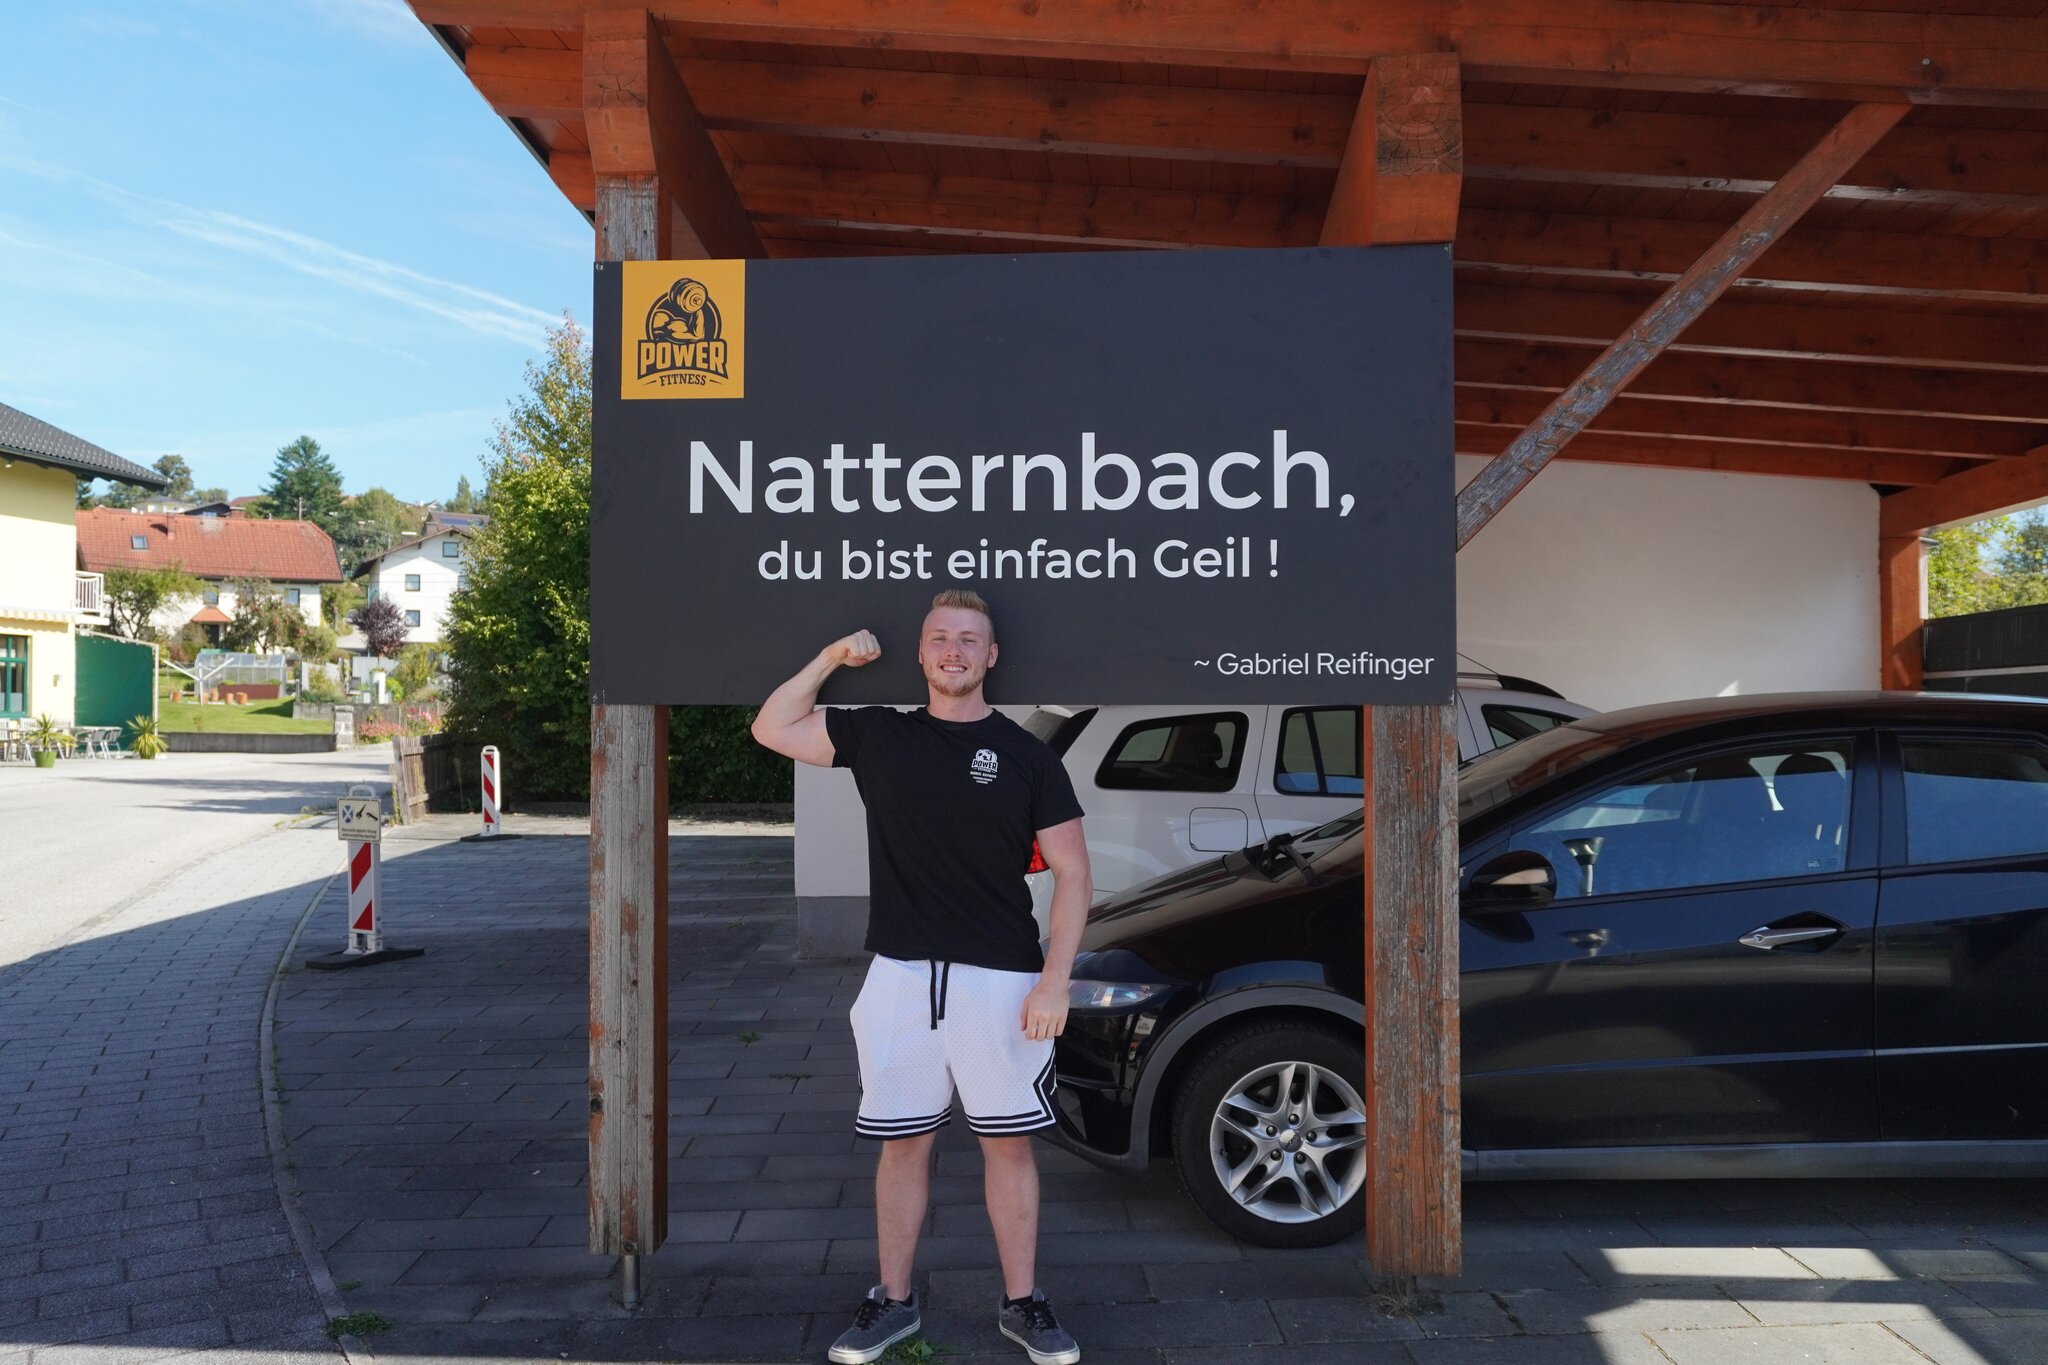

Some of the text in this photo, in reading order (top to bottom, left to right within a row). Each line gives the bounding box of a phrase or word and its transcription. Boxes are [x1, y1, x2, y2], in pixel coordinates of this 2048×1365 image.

[640, 341, 725, 375] POWER
[659, 373, 707, 386] FITNESS
[689, 430, 1356, 517] Natternbach,
[757, 536, 1279, 580] du bist einfach Geil !
[1216, 652, 1309, 675] Gabriel
[1317, 652, 1435, 681] Reifinger
[972, 759, 997, 770] POWER
